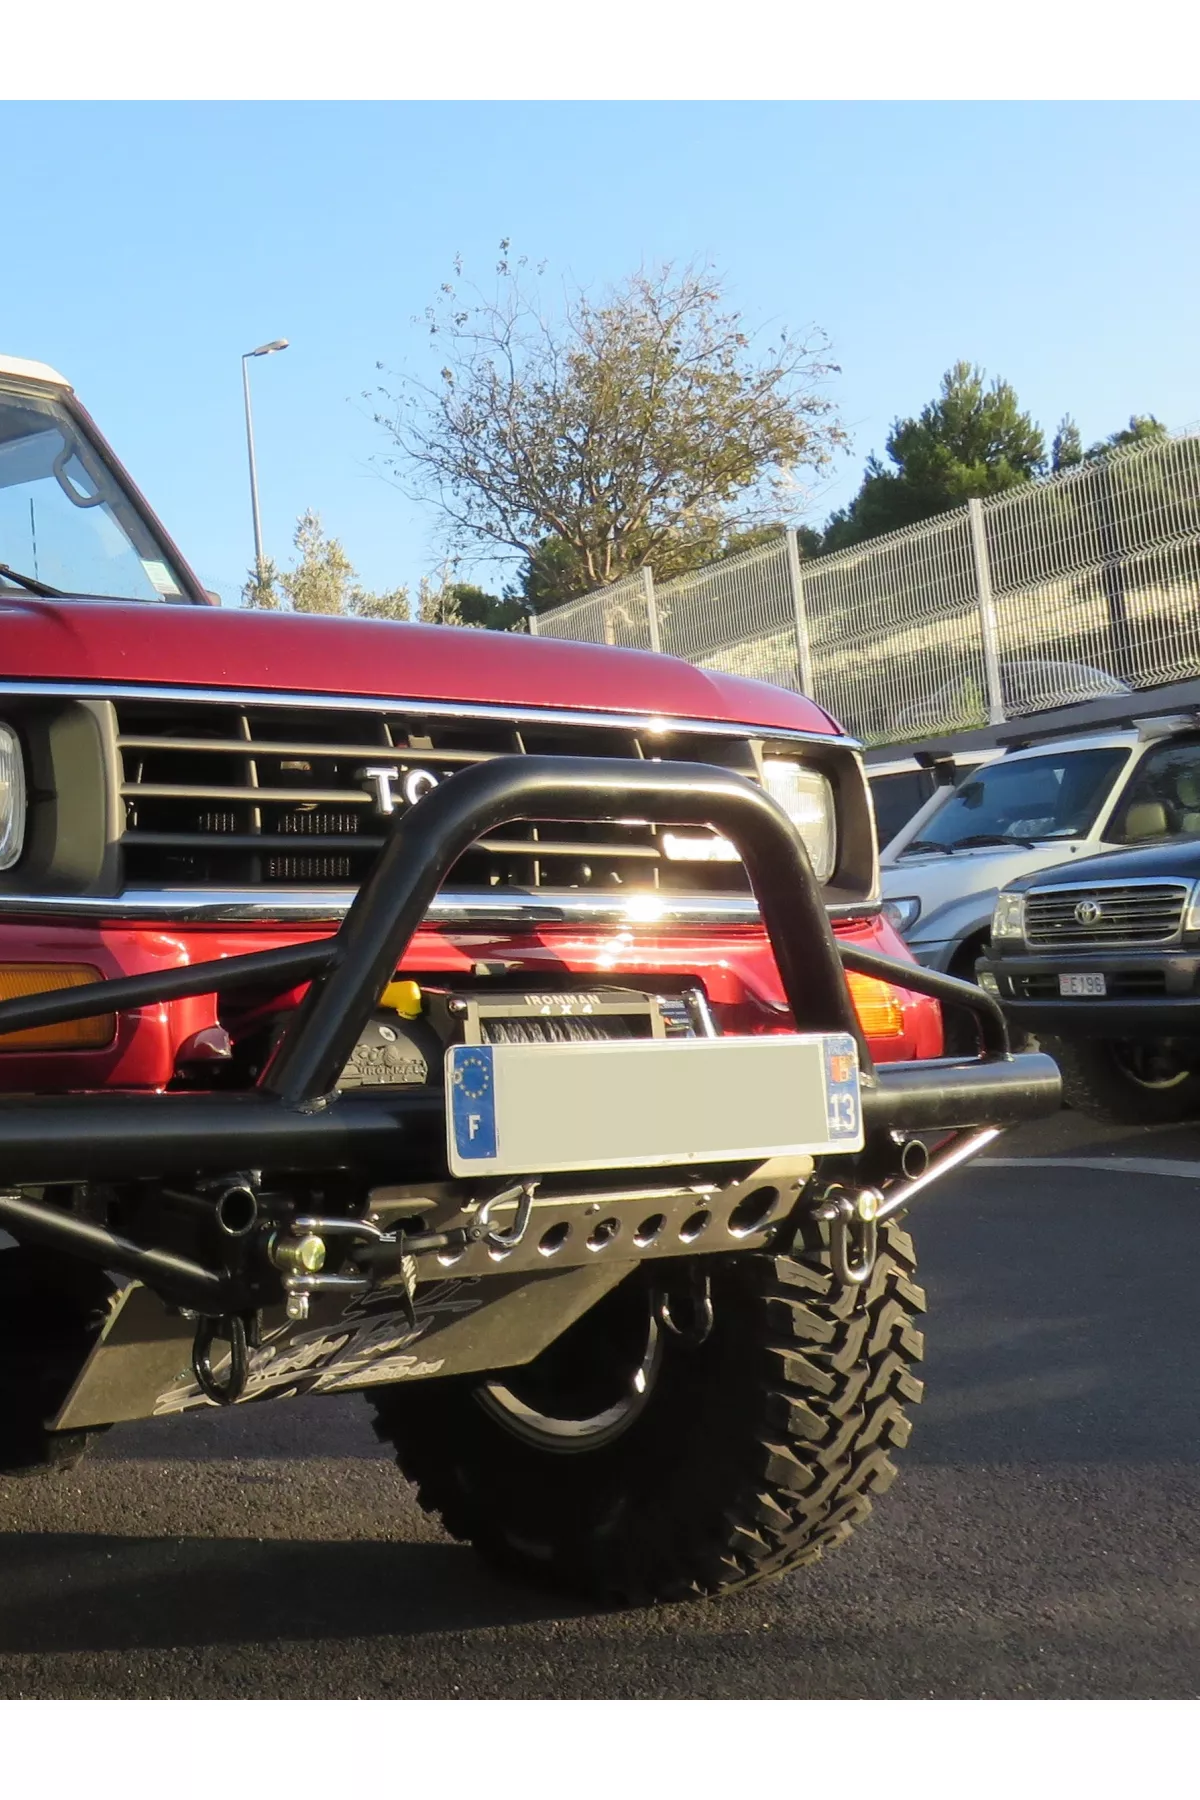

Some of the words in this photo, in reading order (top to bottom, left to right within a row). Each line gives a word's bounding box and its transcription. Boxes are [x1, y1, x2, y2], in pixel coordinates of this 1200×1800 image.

[524, 995, 600, 1006] IRONMAN
[540, 1004, 550, 1015] 4
[582, 1004, 593, 1014] 4
[830, 1093, 856, 1131] 13
[468, 1114, 481, 1140] F
